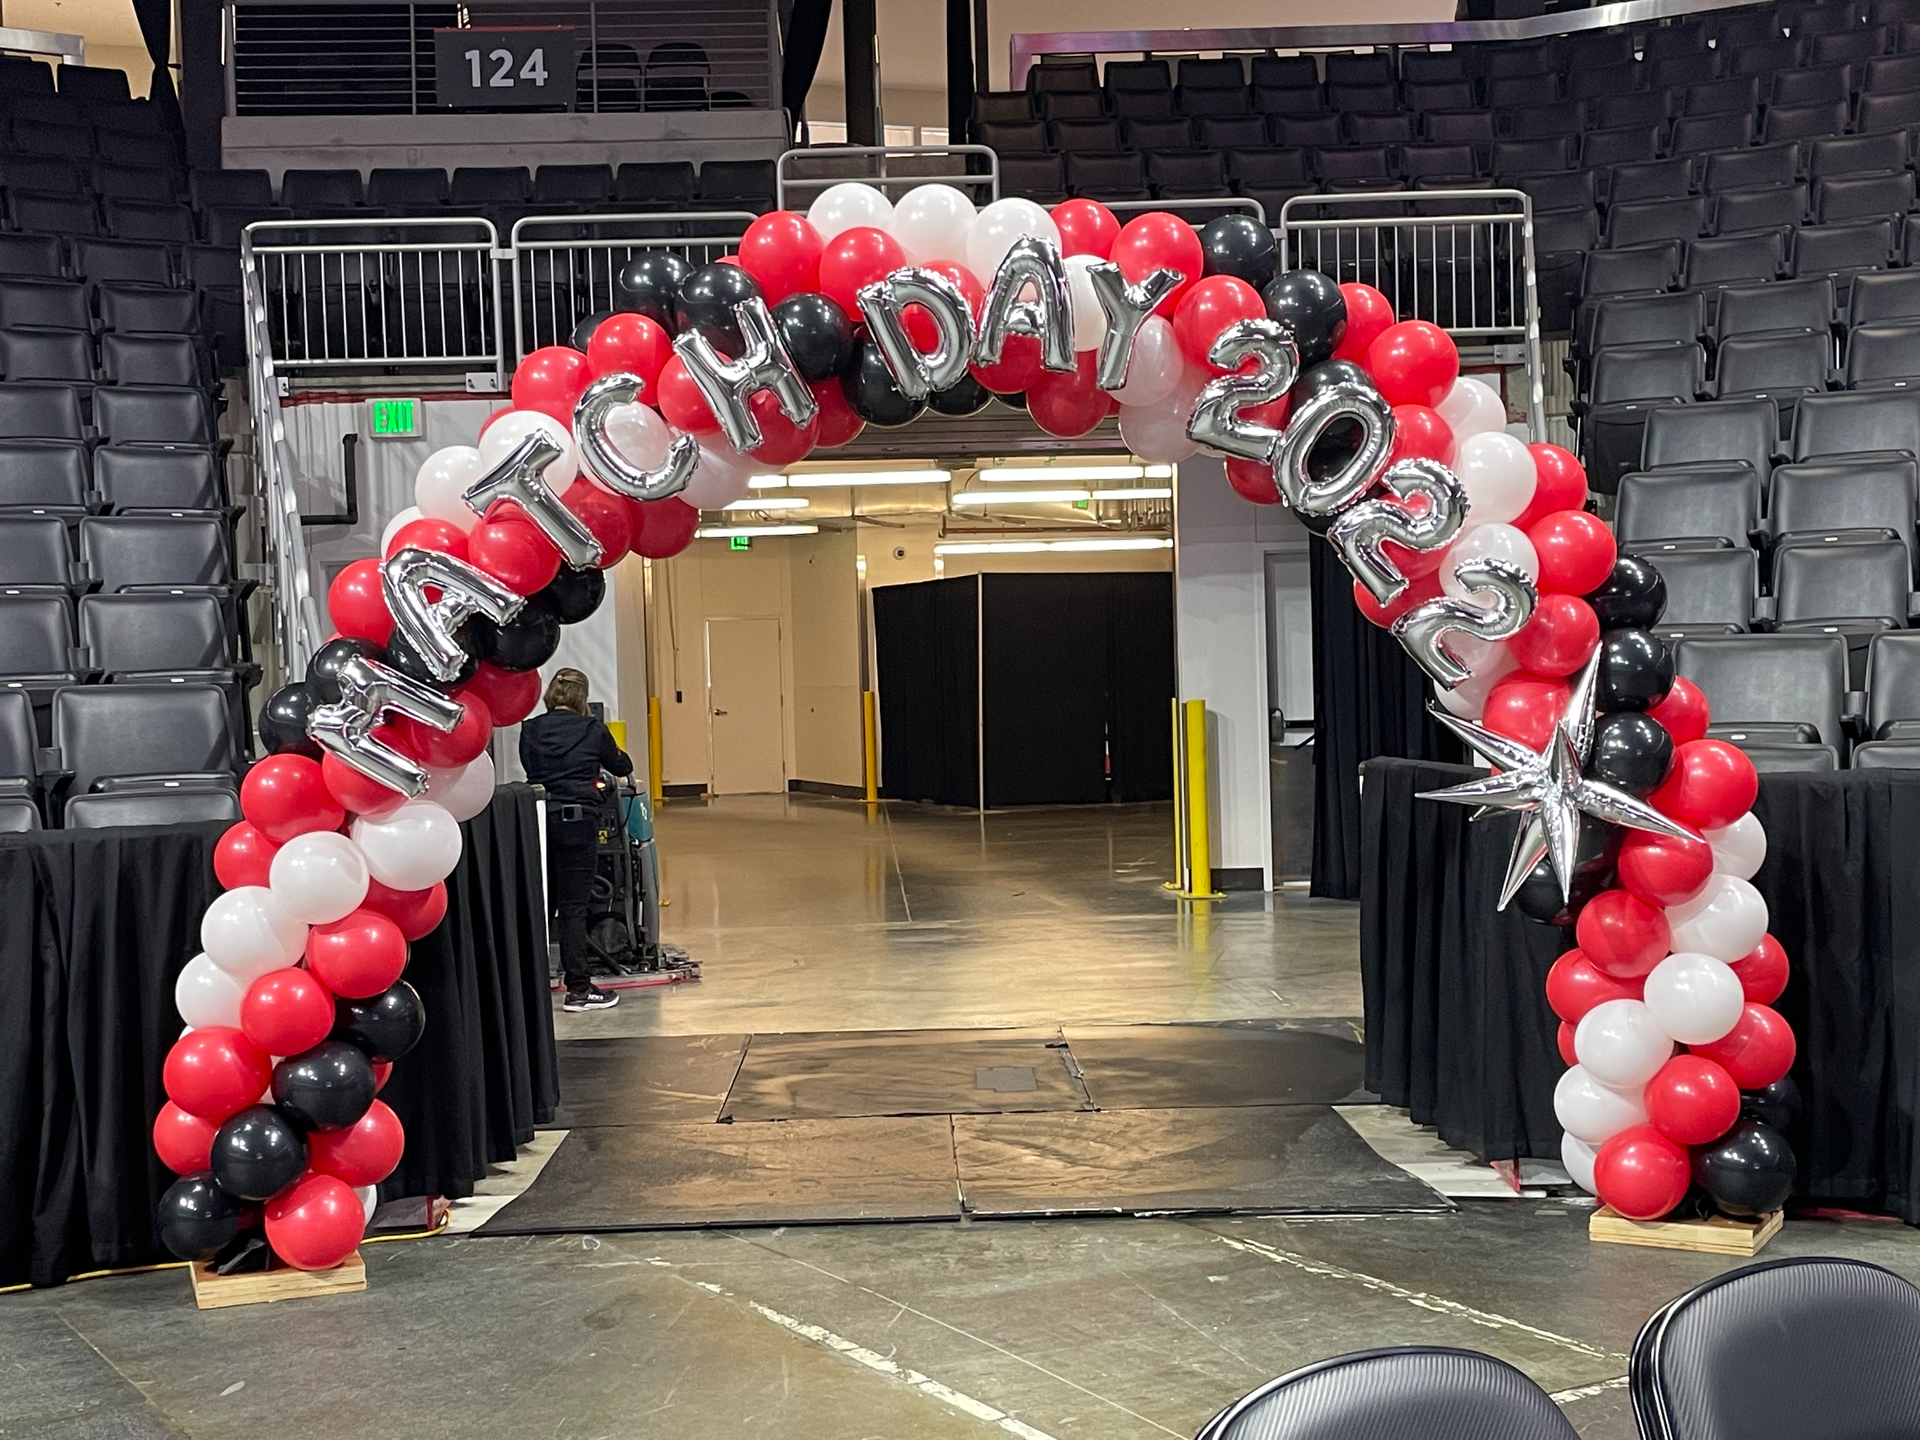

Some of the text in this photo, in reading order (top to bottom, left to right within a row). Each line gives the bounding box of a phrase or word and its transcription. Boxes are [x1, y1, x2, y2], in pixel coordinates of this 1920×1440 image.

[464, 48, 549, 88] 124
[374, 401, 414, 433] EXIT
[306, 233, 1540, 799] MATCH DAY 2022
